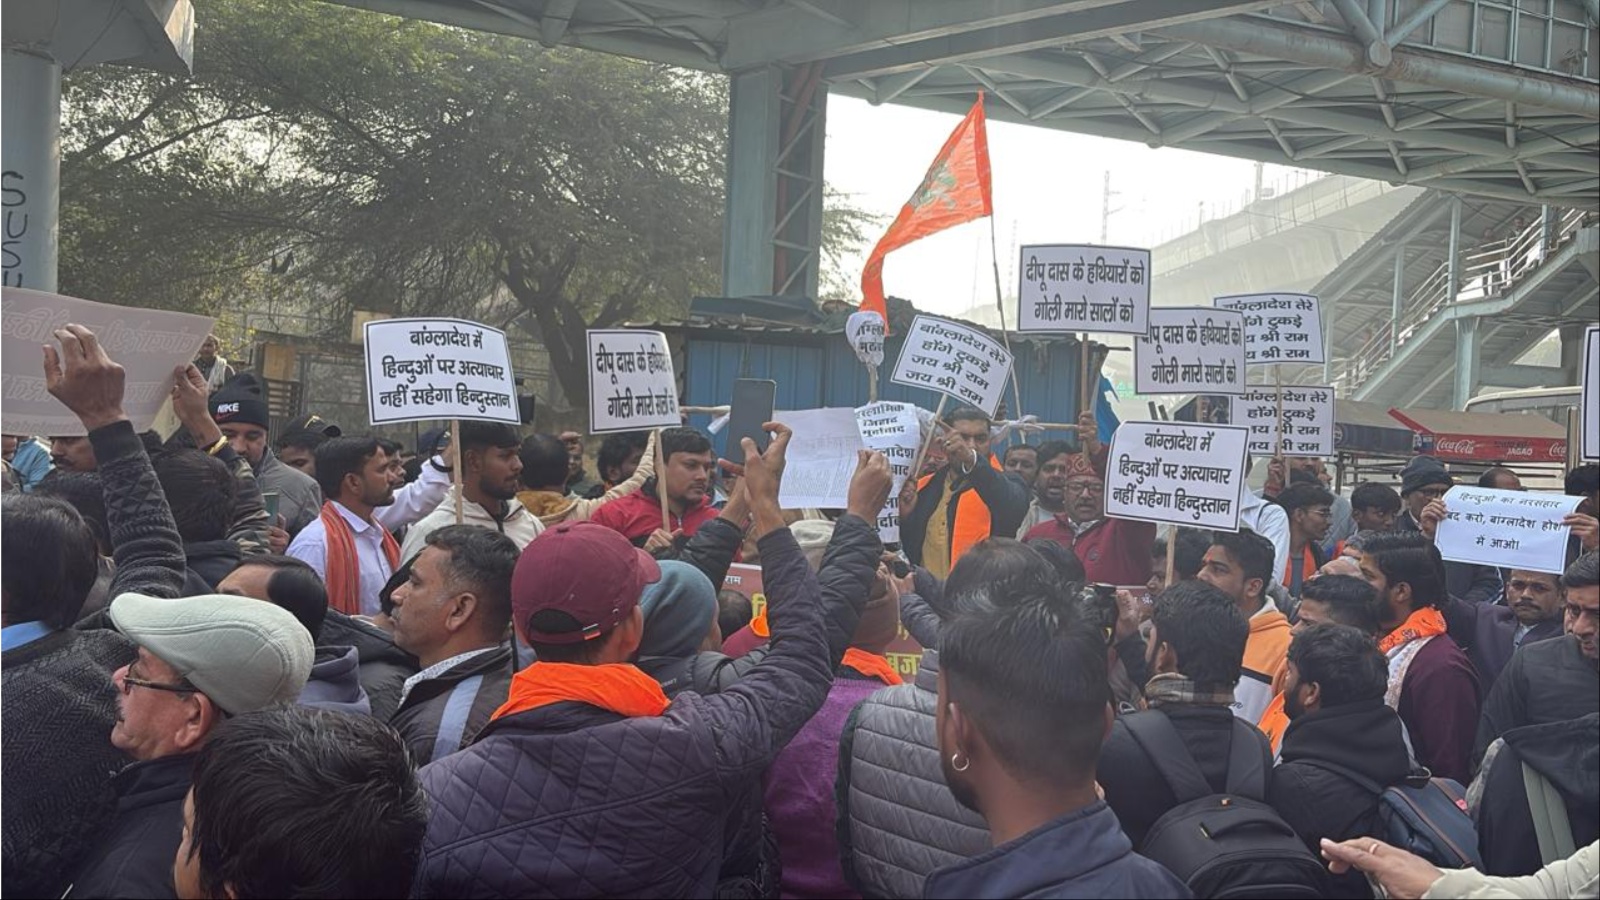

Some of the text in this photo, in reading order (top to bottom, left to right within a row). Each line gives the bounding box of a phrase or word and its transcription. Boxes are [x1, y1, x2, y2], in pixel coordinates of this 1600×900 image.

[1026, 255, 1144, 292] दीपू दास के हथियारों को
[1034, 293, 1134, 323] गोली मारो सालों को
[1294, 298, 1313, 311] तेरे
[410, 325, 483, 349] बांग्लादेश में
[1162, 325, 1184, 344] दास
[1185, 317, 1197, 343] के
[1260, 330, 1280, 342] श्री
[1284, 332, 1309, 342] राम
[920, 323, 1006, 366] बांग्लादेश तेरे
[922, 339, 953, 355] होंगे
[1261, 345, 1280, 359] श्री
[1284, 349, 1310, 359] राम
[382, 354, 505, 384] हिन्दुओं पर अत्याचार
[595, 342, 618, 385] दीपू
[616, 352, 636, 373] दास
[636, 343, 646, 372] के
[912, 354, 990, 391] जय श्री राम
[1151, 356, 1237, 384] गोली मारो सालों को
[379, 382, 511, 414] नहीं सहेगा हिन्दुस्तान
[905, 369, 984, 405] जय श्री राम
[1309, 390, 1328, 403] तेरे
[217, 402, 239, 413] NIKE
[607, 387, 634, 419] गोली
[635, 387, 655, 416] मारो
[1247, 406, 1277, 418] होंगे
[1144, 428, 1215, 452] बांग्लादेश में
[1297, 426, 1320, 435] राम
[1297, 442, 1320, 451] राम
[1119, 453, 1232, 484] हिन्दुओं पर अत्याचार
[1113, 482, 1232, 520] नहीं सहेगा हिन्दुस्तान
[1500, 496, 1515, 505] का
[1489, 513, 1537, 529] बांग्लादेश
[1541, 519, 1562, 532] होश
